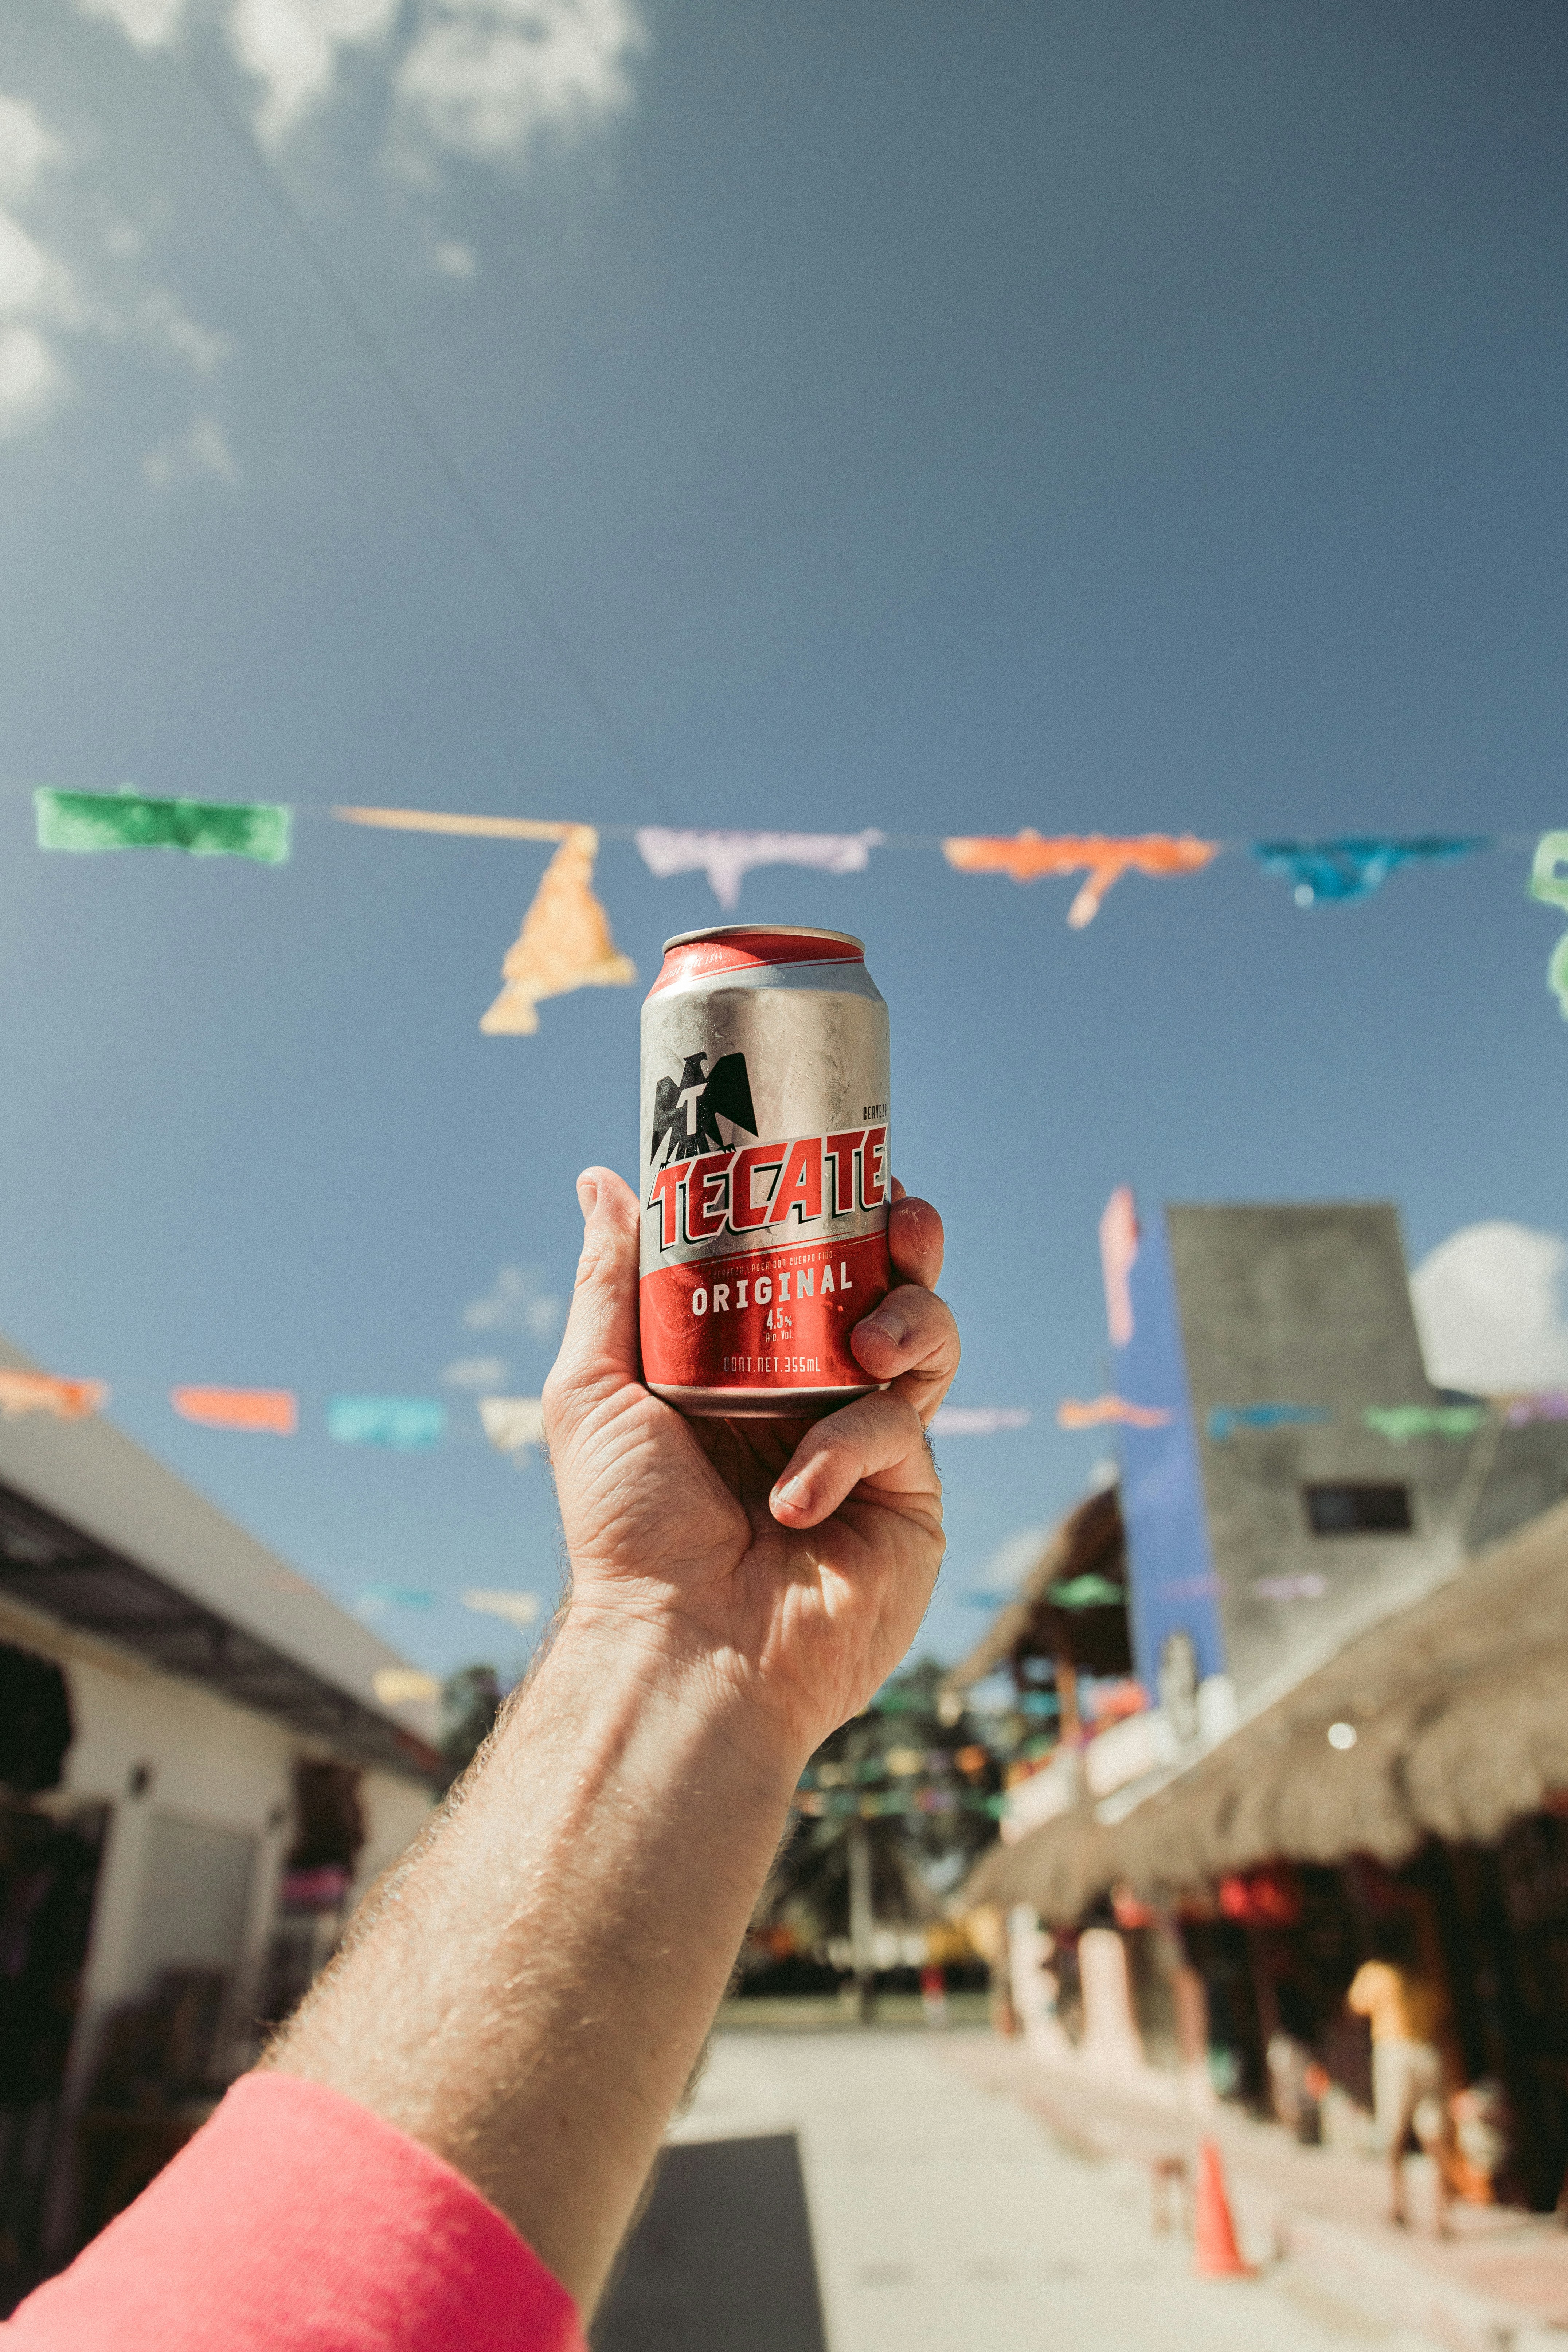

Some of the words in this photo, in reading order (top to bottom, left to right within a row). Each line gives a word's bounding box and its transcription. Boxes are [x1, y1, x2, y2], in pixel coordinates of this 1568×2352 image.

[676, 1083, 707, 1136] T
[863, 1104, 887, 1120] CERVEZA
[647, 1124, 887, 1253] TECATE
[747, 1261, 769, 1273] LAGER
[773, 1259, 786, 1269] CON
[789, 1254, 815, 1265] CUERPO
[818, 1251, 832, 1260] FINO
[692, 1261, 852, 1316] ORIGINAL
[766, 1307, 792, 1330] 4.5%
[766, 1332, 779, 1343] Alc.
[781, 1329, 793, 1340] Vol.
